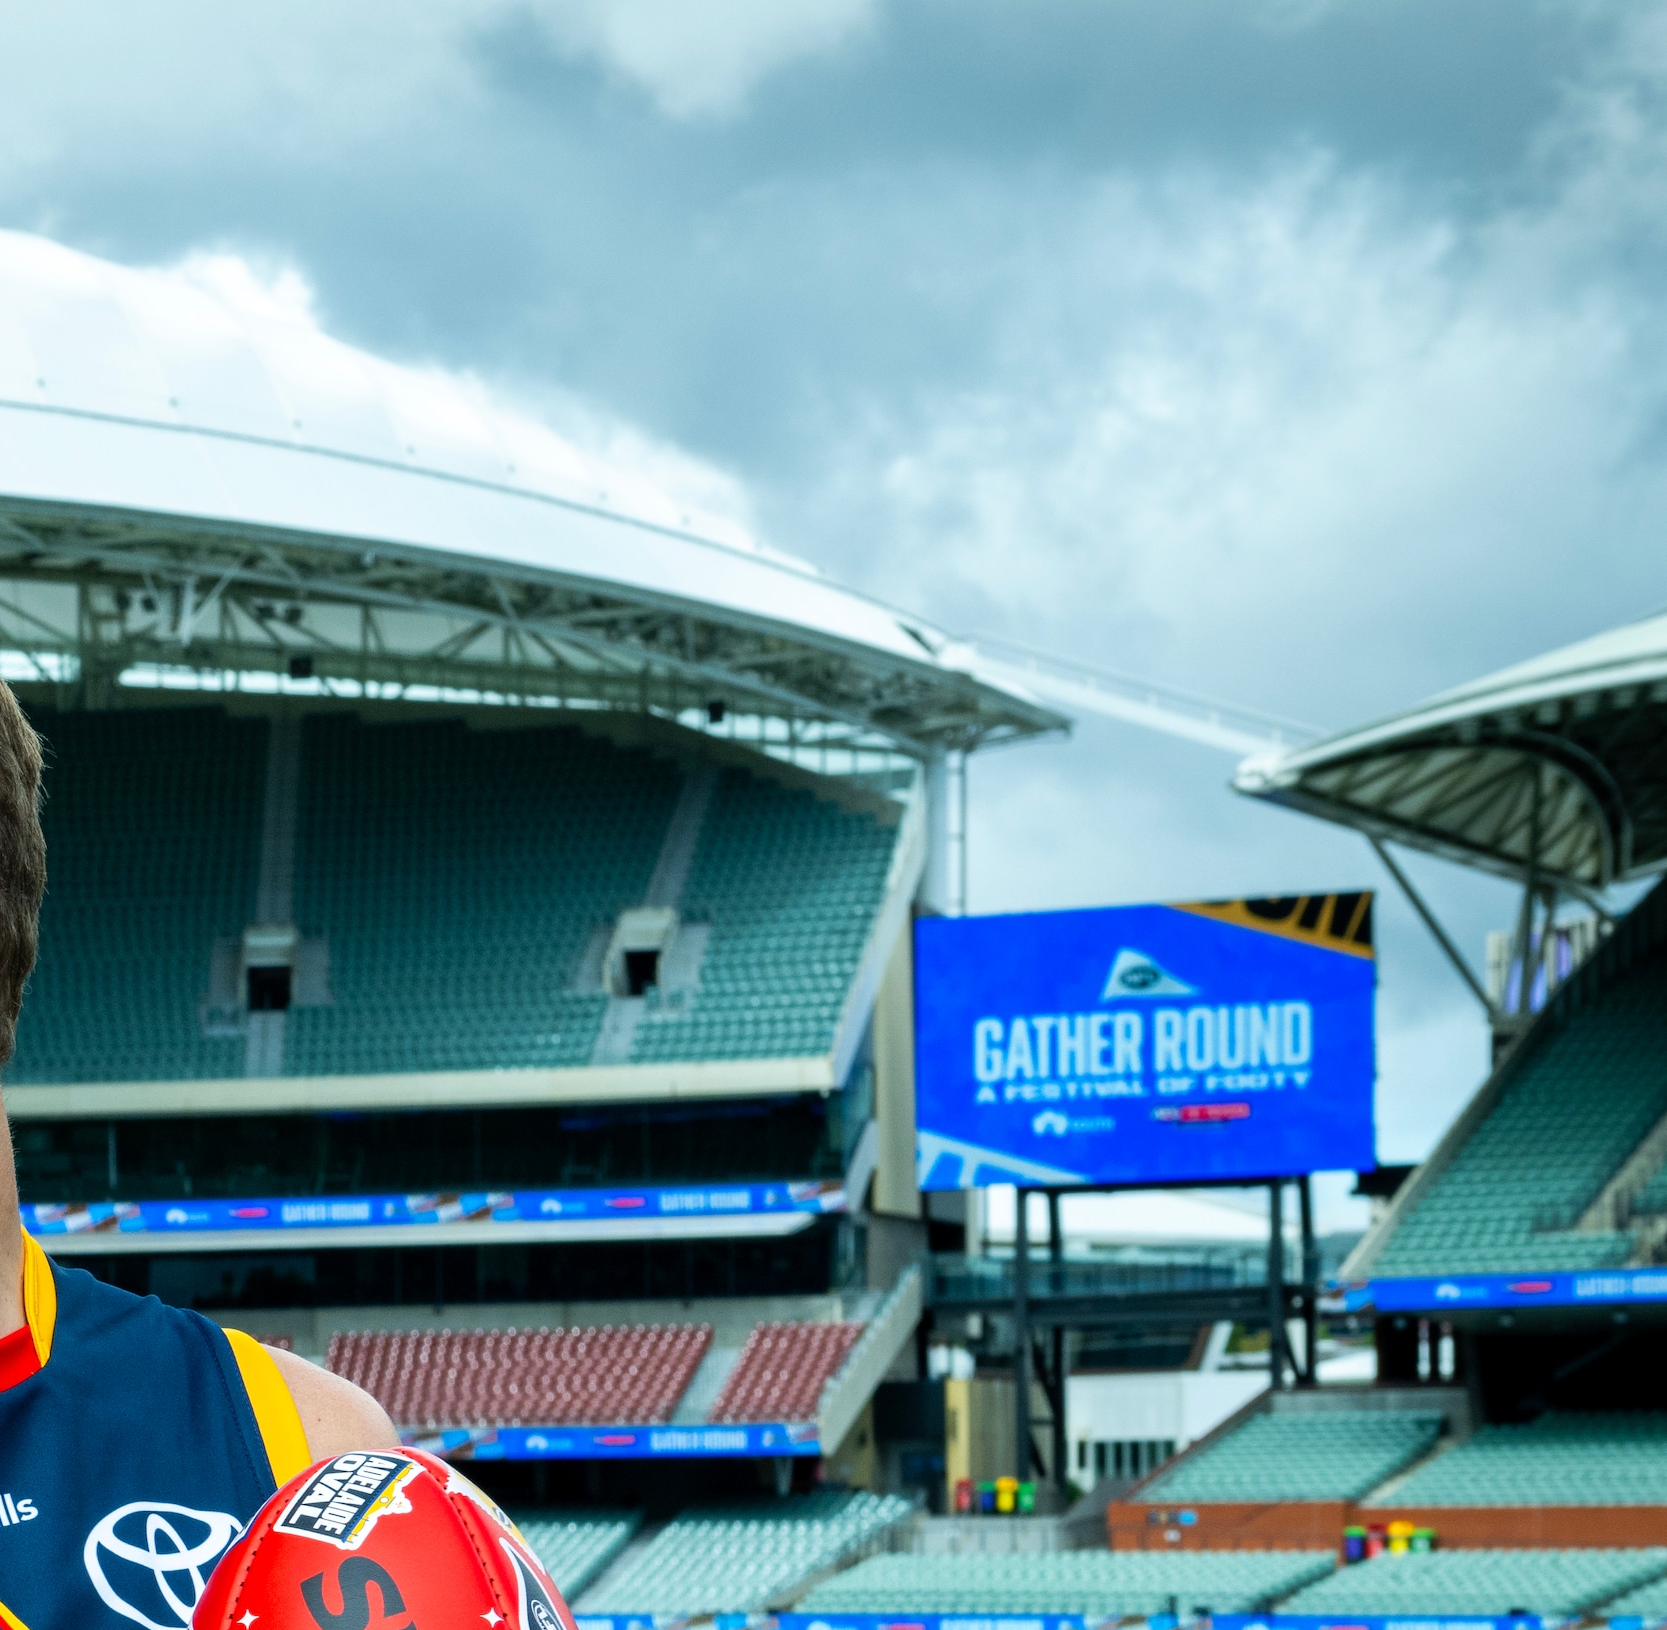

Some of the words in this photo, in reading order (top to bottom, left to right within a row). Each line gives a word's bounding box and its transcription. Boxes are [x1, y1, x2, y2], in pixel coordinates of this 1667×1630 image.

[974, 1011, 1143, 1083] GATHER
[1154, 1003, 1312, 1072] ROUND
[289, 1454, 367, 1525] OVAL
[313, 1457, 398, 1535] ADELAIDE
